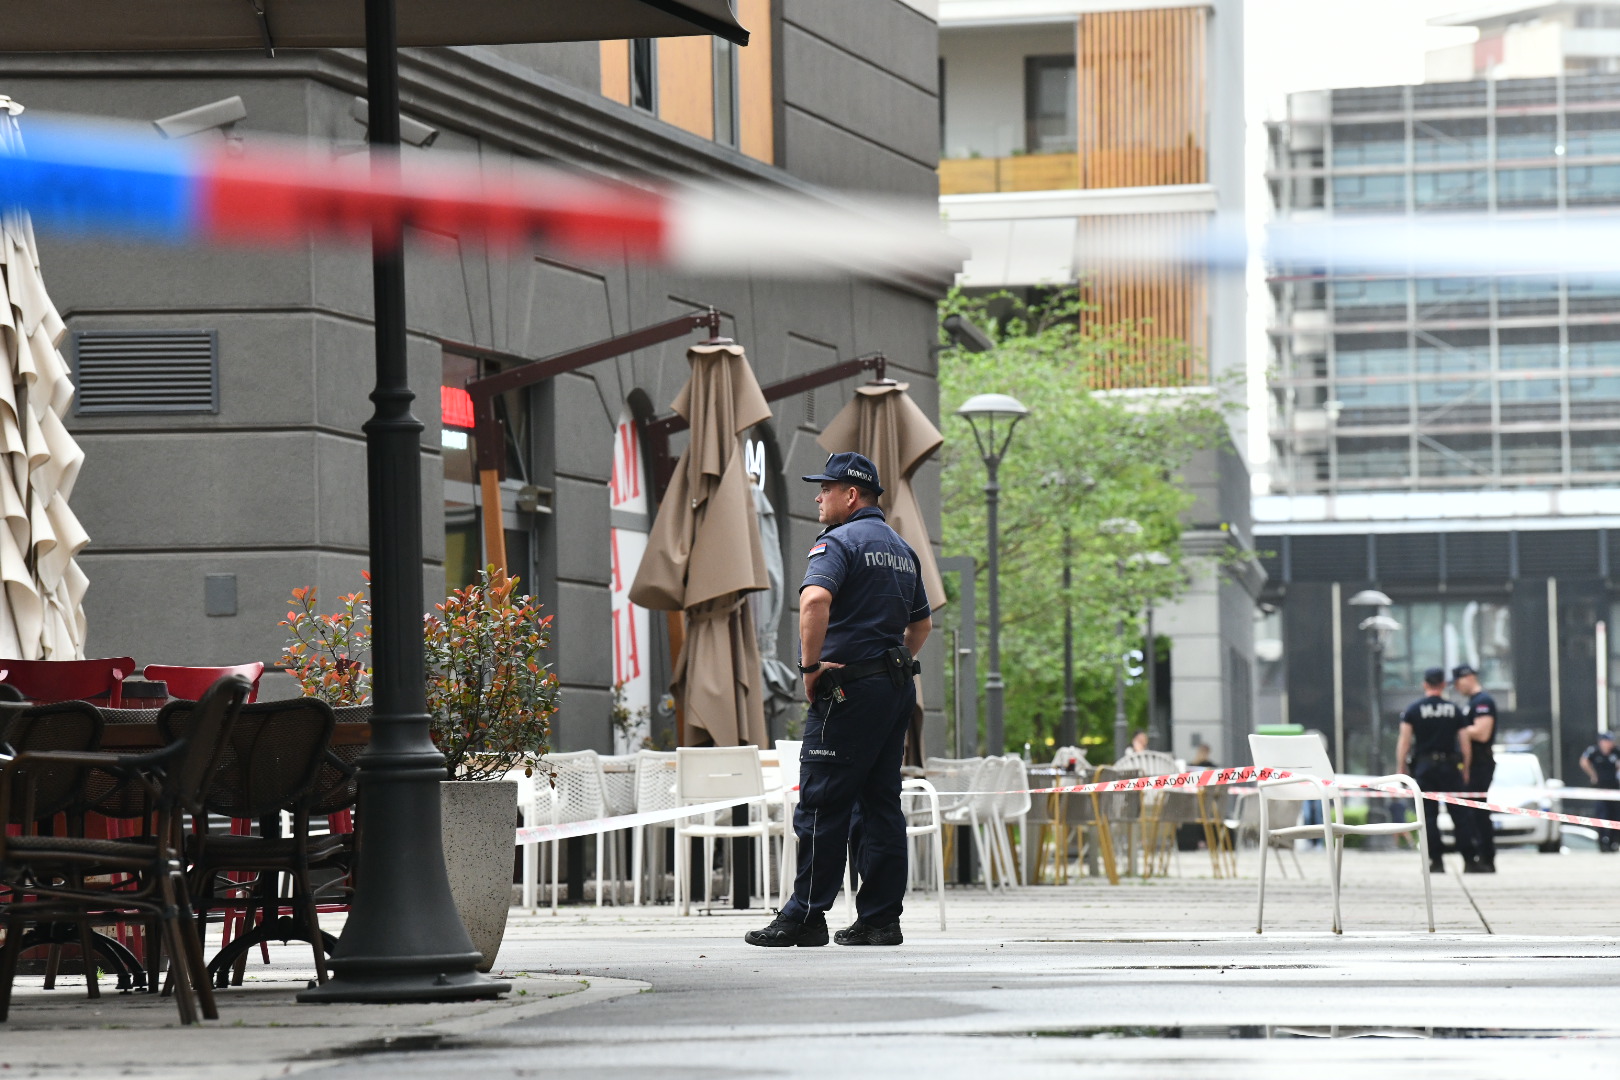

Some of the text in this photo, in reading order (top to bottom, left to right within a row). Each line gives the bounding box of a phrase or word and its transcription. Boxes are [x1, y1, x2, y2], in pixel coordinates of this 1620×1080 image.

[864, 551, 917, 574] ПОЛИЦИЈА
[808, 749, 836, 757] ПОЛИЦИЈА
[1155, 776, 1195, 787] RADOVI
[1217, 769, 1257, 782] PAŽNJA
